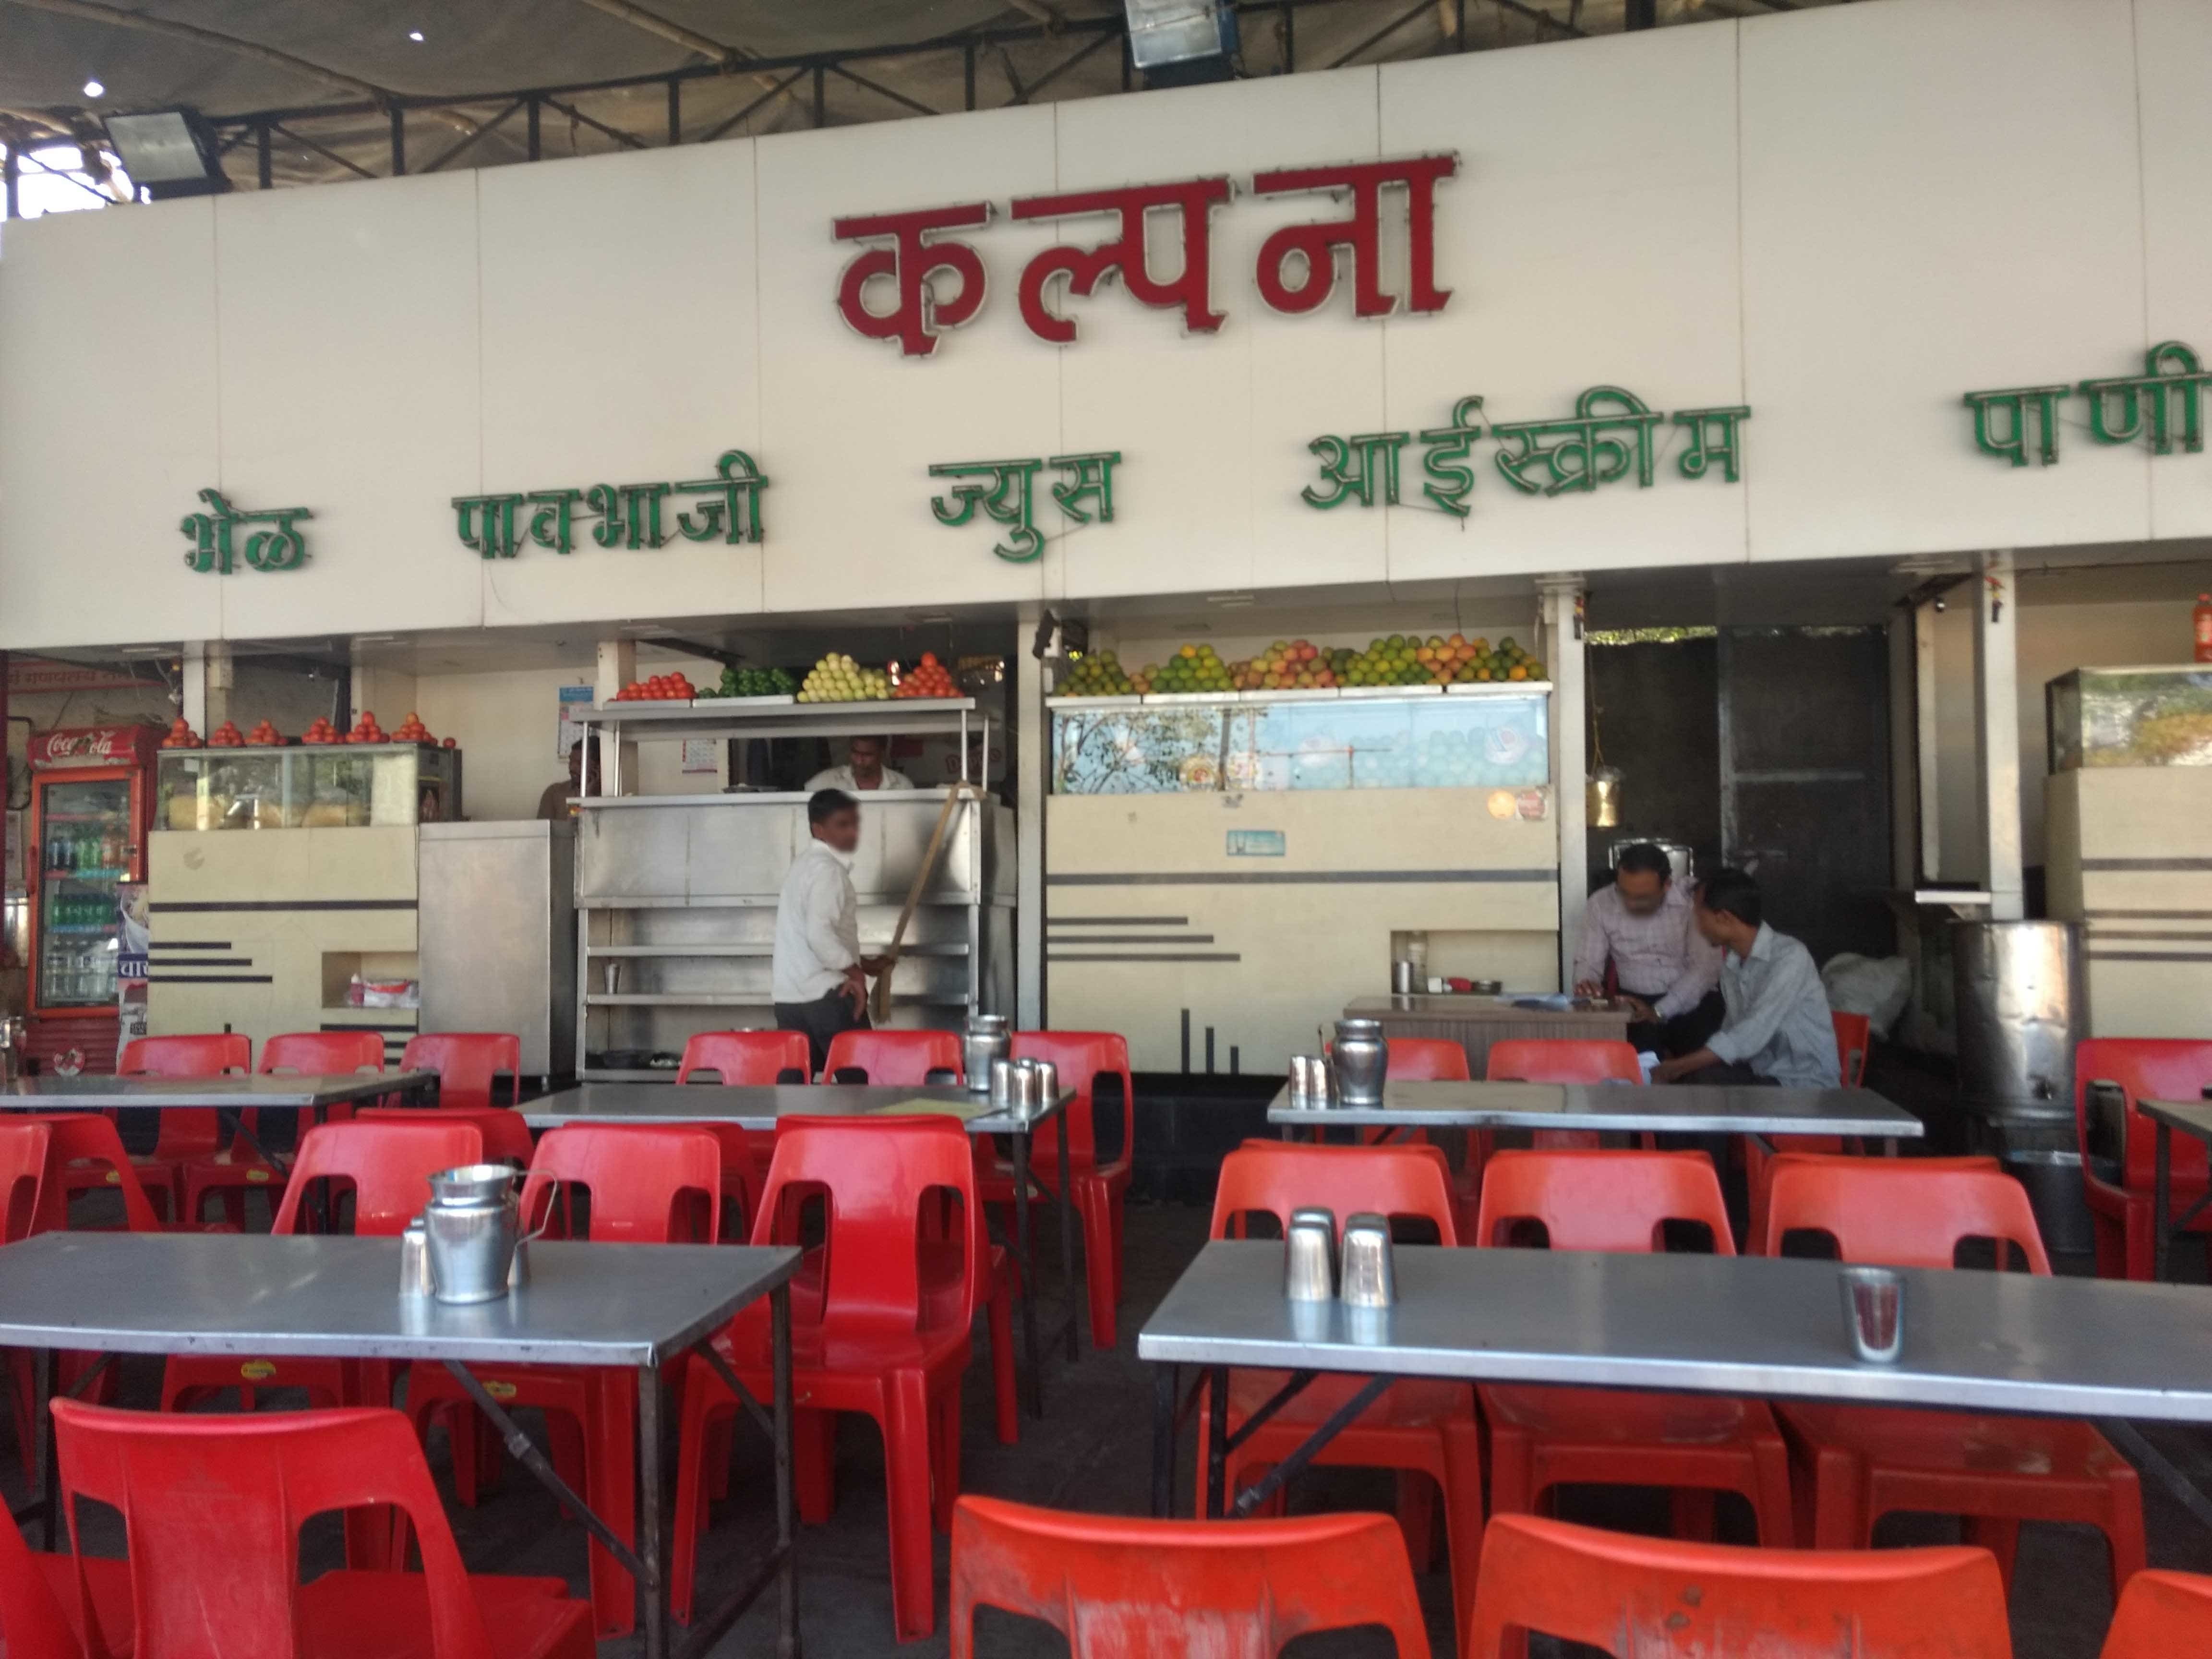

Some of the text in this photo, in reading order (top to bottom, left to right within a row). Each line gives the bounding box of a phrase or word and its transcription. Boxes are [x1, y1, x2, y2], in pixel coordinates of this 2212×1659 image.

[832, 154, 1456, 356] कल्पना
[181, 340, 2212, 574] भेळ पावभाजी ज्युस आईस्क्रीम पाणी
